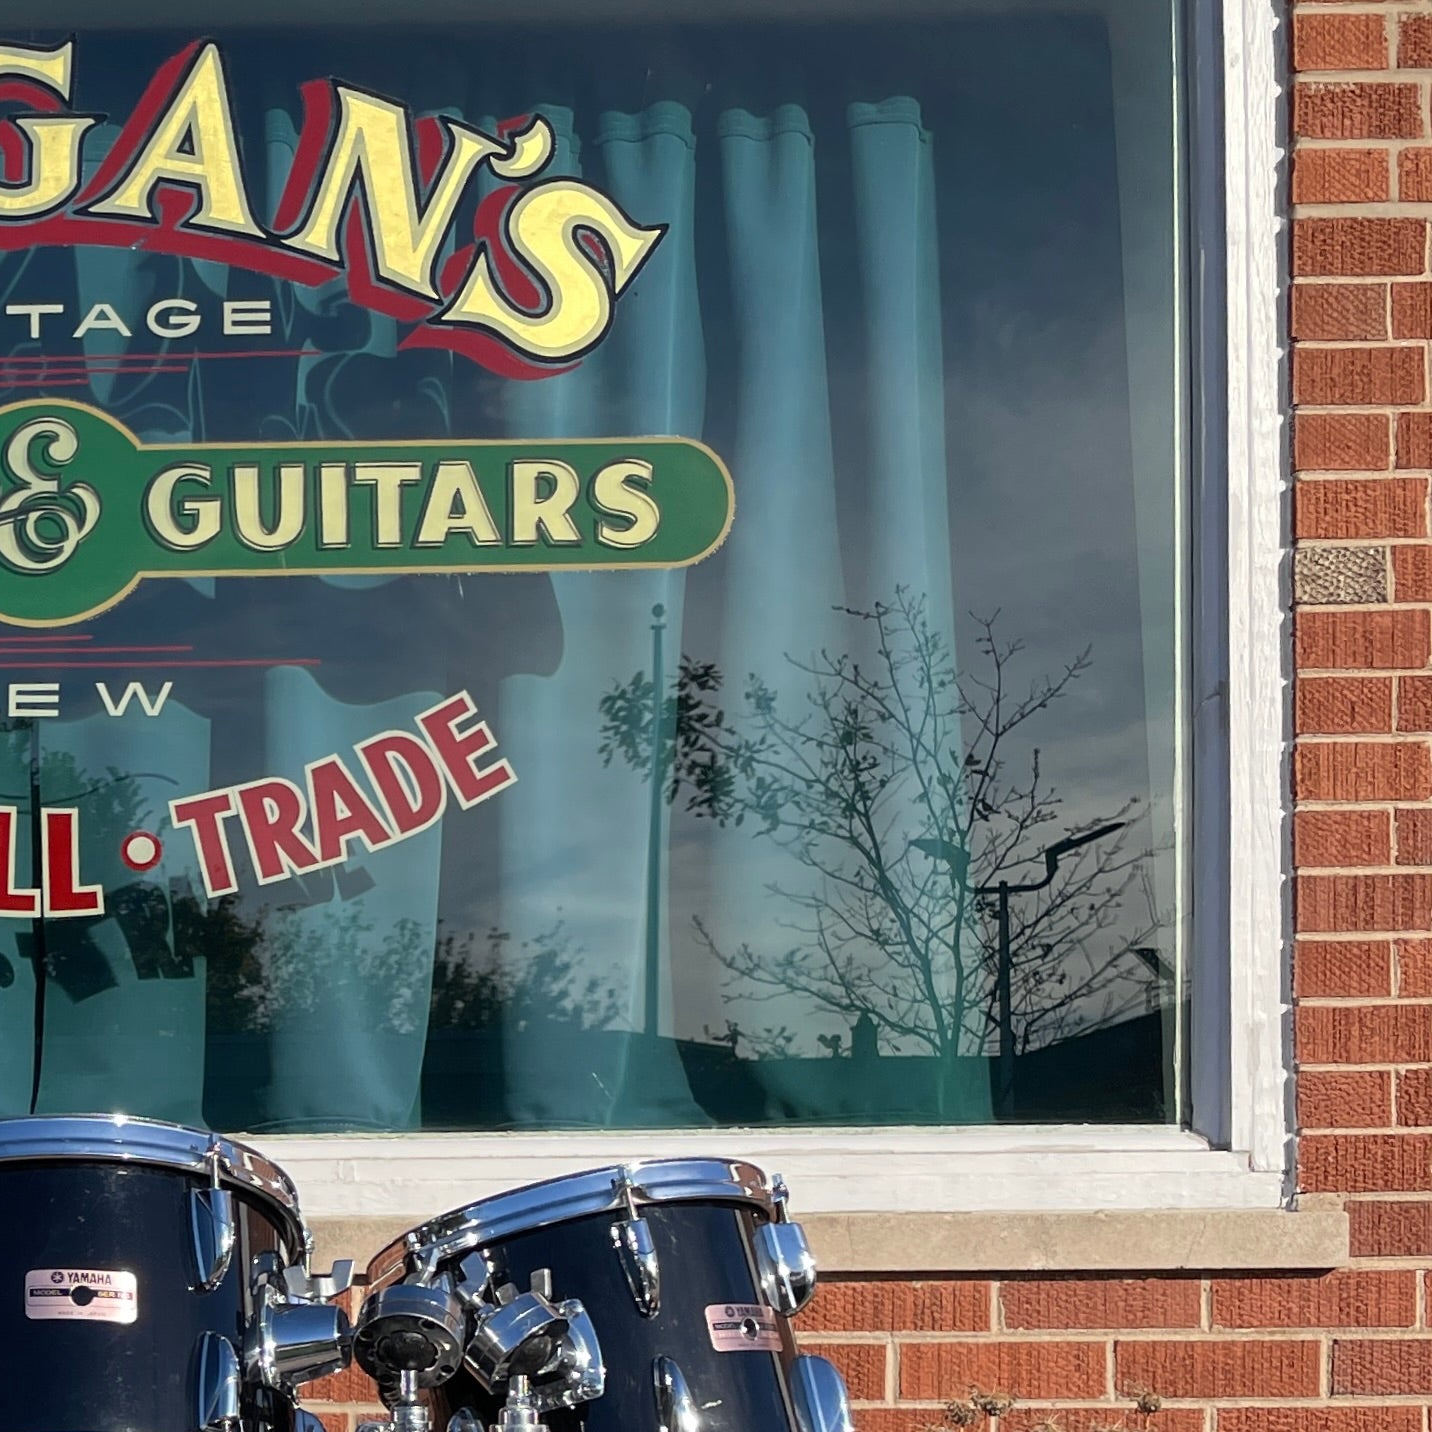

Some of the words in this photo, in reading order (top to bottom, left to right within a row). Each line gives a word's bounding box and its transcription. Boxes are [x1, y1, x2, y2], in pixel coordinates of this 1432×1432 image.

[142, 457, 662, 552] GUITARS
[168, 689, 519, 899] TRADE
[67, 1271, 113, 1285] YAMAHA
